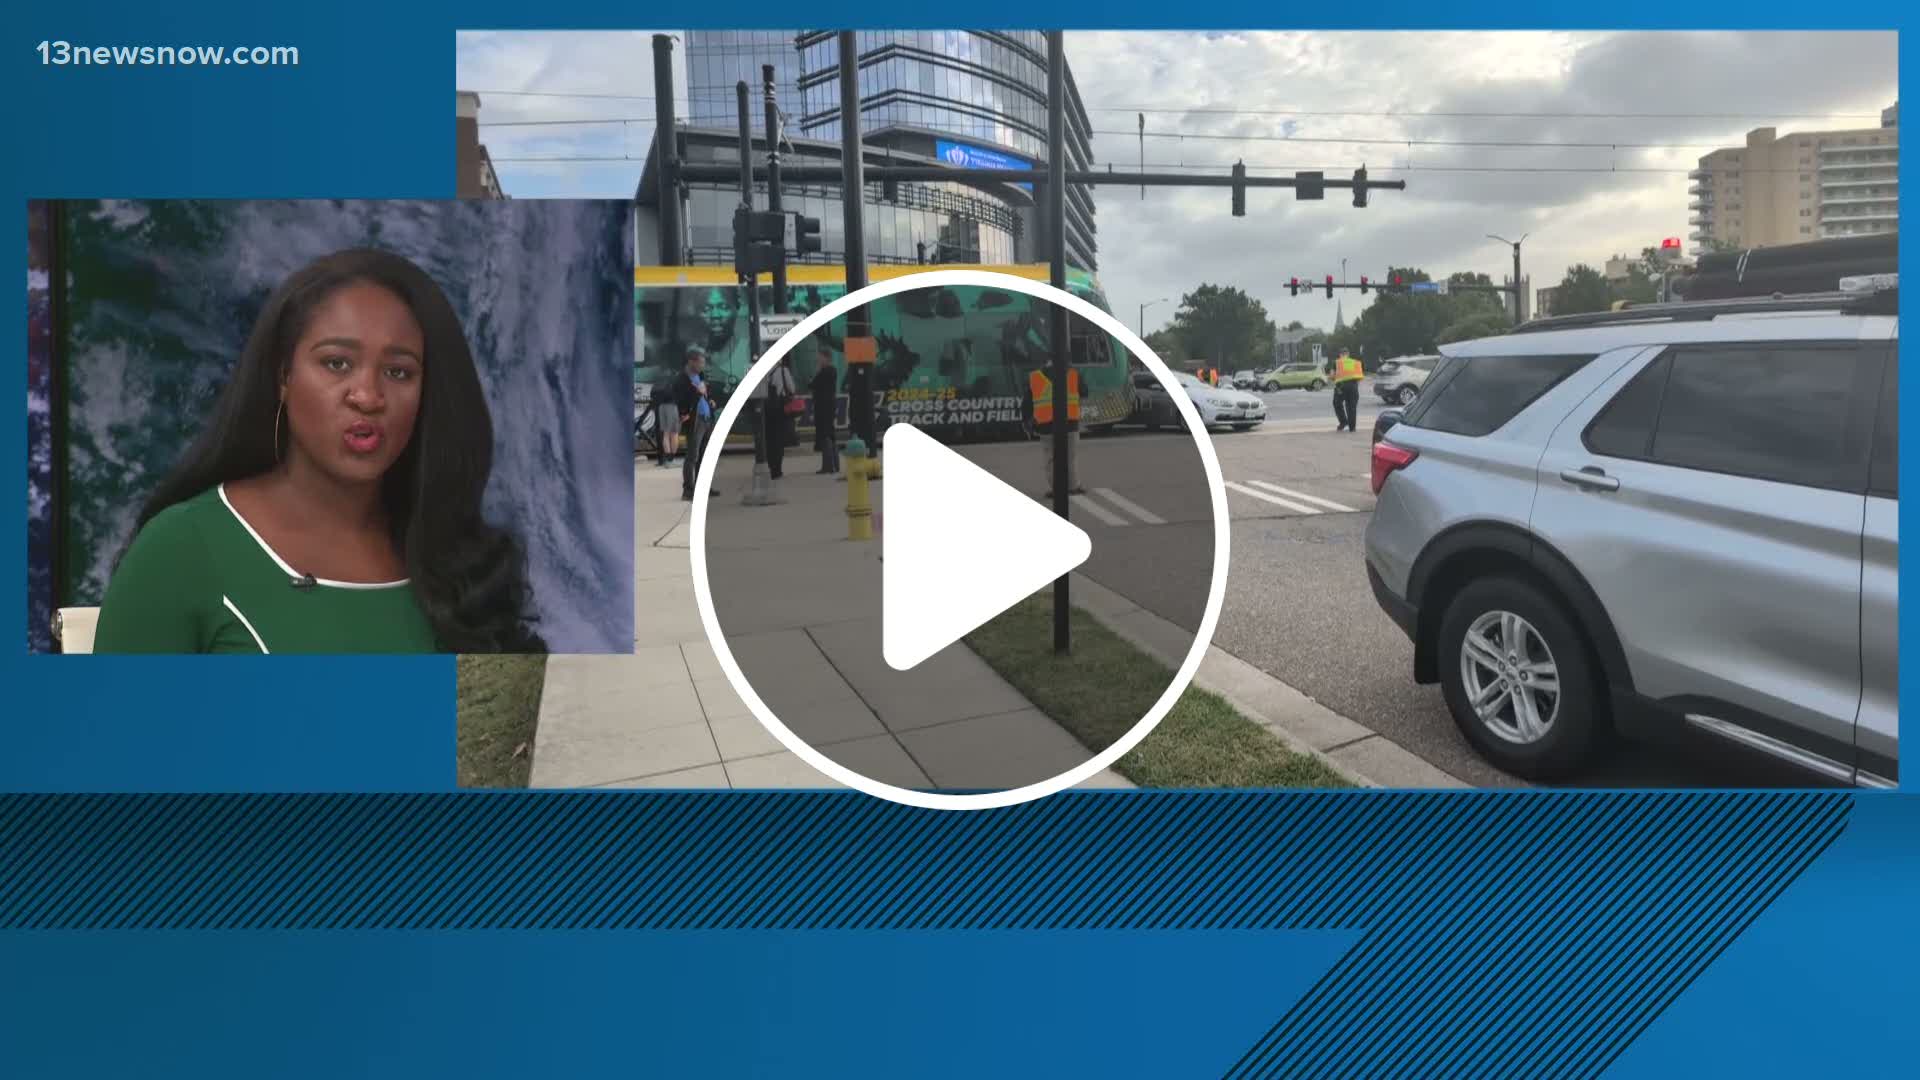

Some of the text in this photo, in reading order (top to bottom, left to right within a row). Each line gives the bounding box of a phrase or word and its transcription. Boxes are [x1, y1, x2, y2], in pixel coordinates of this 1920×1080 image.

[887, 399, 945, 413] CROSS
[947, 396, 1024, 411] COUNTRY
[888, 408, 1023, 425] TRACK AND FIEL
